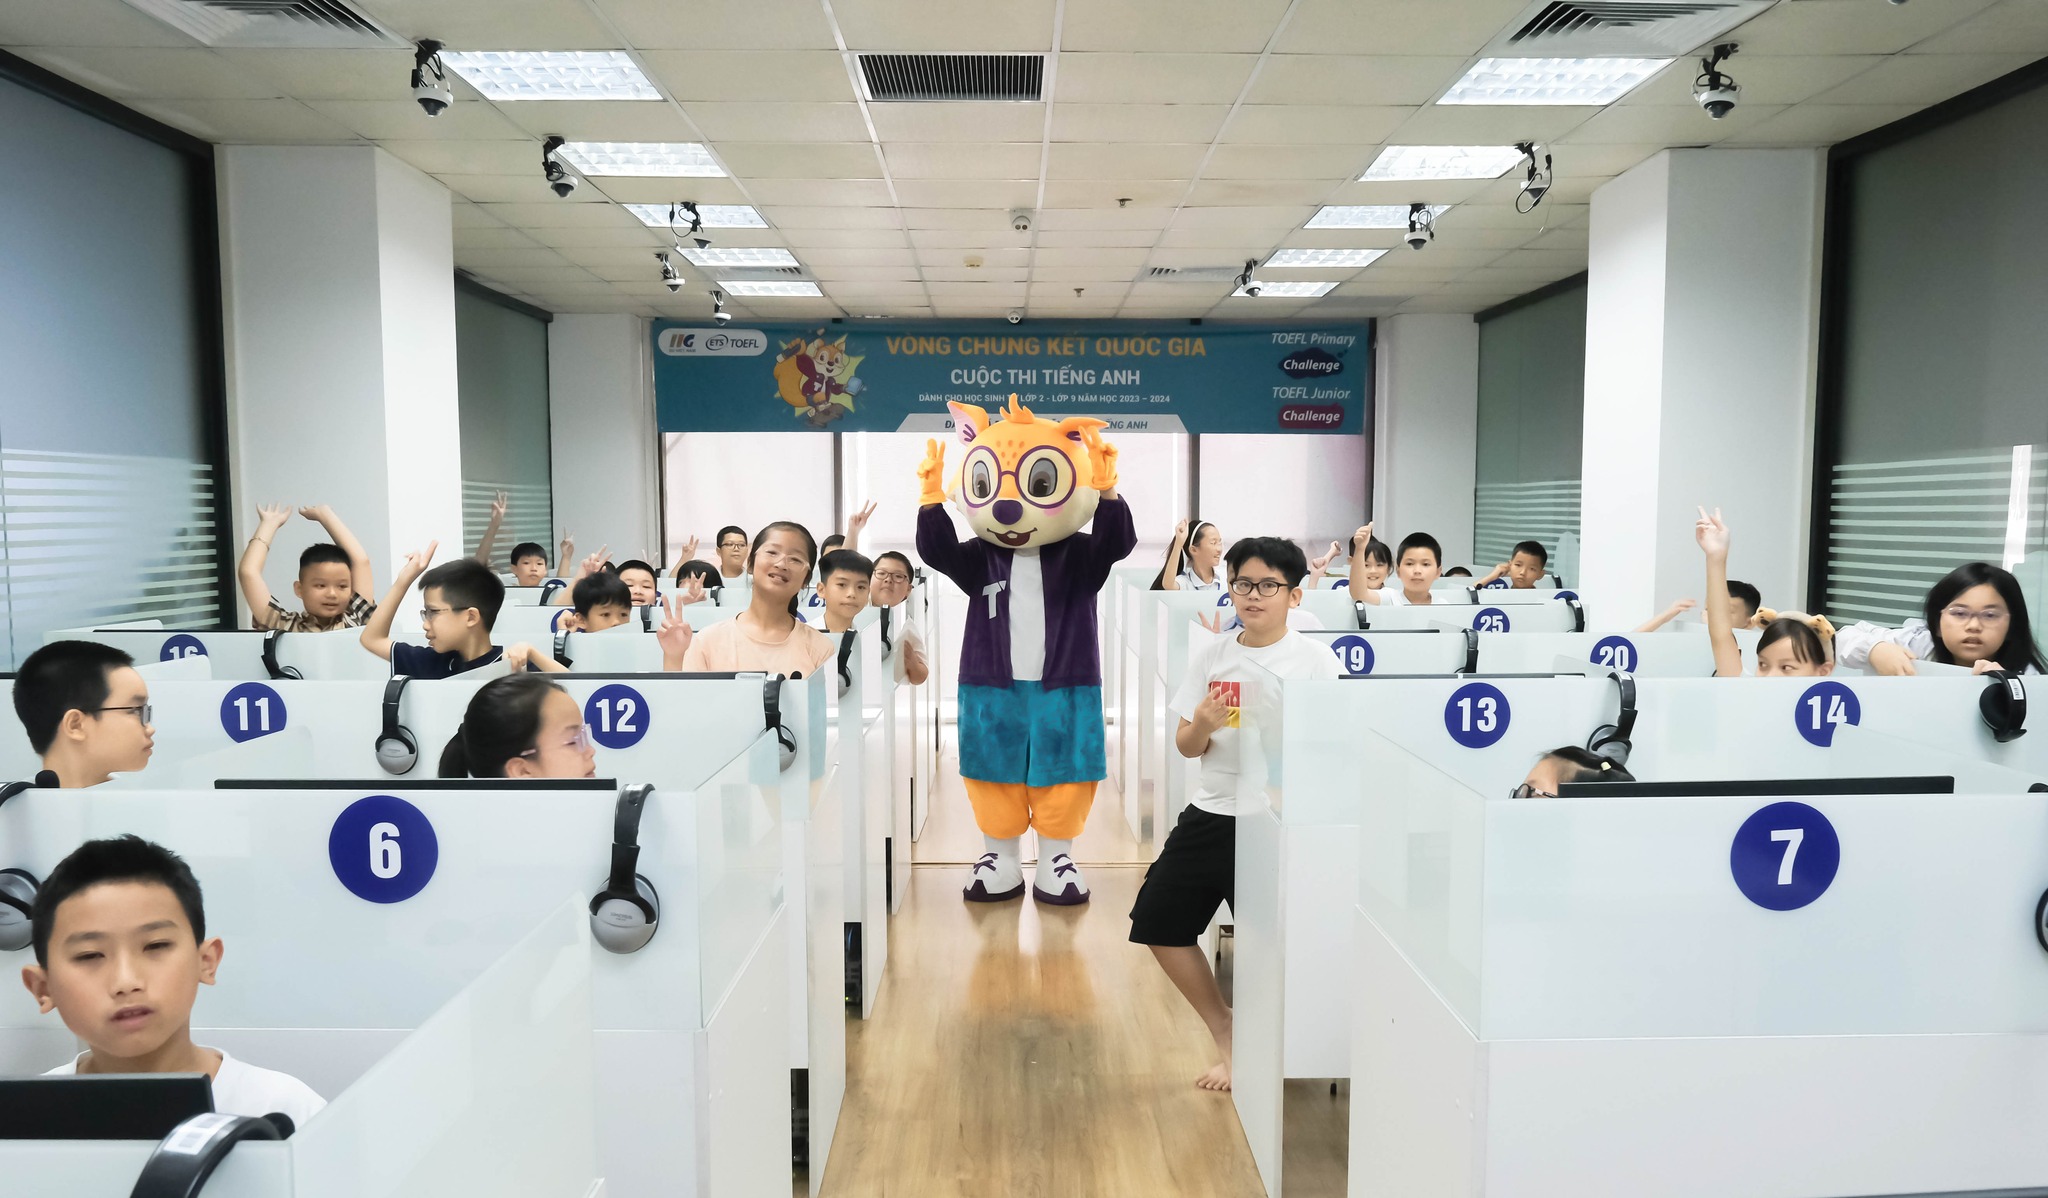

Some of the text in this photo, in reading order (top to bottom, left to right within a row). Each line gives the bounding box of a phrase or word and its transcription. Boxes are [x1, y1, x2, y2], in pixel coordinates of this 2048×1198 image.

[709, 338, 759, 349] ETS TOEFL
[958, 336, 1040, 356] CHUNG
[1168, 336, 1207, 357] GIA
[1271, 333, 1356, 348] TOEFL Primary
[951, 364, 1141, 388] CUỘC THI TIẾNG ANH
[1283, 359, 1340, 373] Challenge
[919, 392, 942, 402] DÀNH
[945, 394, 962, 402] CHO
[964, 394, 982, 404] HỌC
[984, 394, 1004, 402] SINH
[1020, 392, 1037, 402] LỚP
[1052, 392, 1069, 403] LỚP
[1078, 393, 1097, 403] NĂM
[1100, 395, 1117, 404] HỌC
[1119, 395, 1140, 403] 2023
[1150, 395, 1171, 403] 2024
[1272, 387, 1351, 399] TOEFL Junior
[1126, 420, 1148, 430] ANH
[1282, 410, 1340, 424] Challenge
[1480, 615, 1504, 633] 25
[1336, 645, 1365, 672] 19
[1600, 645, 1629, 671] 20
[233, 697, 270, 731] 11
[595, 698, 637, 733] 12
[1457, 697, 1498, 732] 13
[1807, 695, 1847, 730] 14
[368, 822, 401, 879] 6
[1770, 828, 1804, 886] 7
